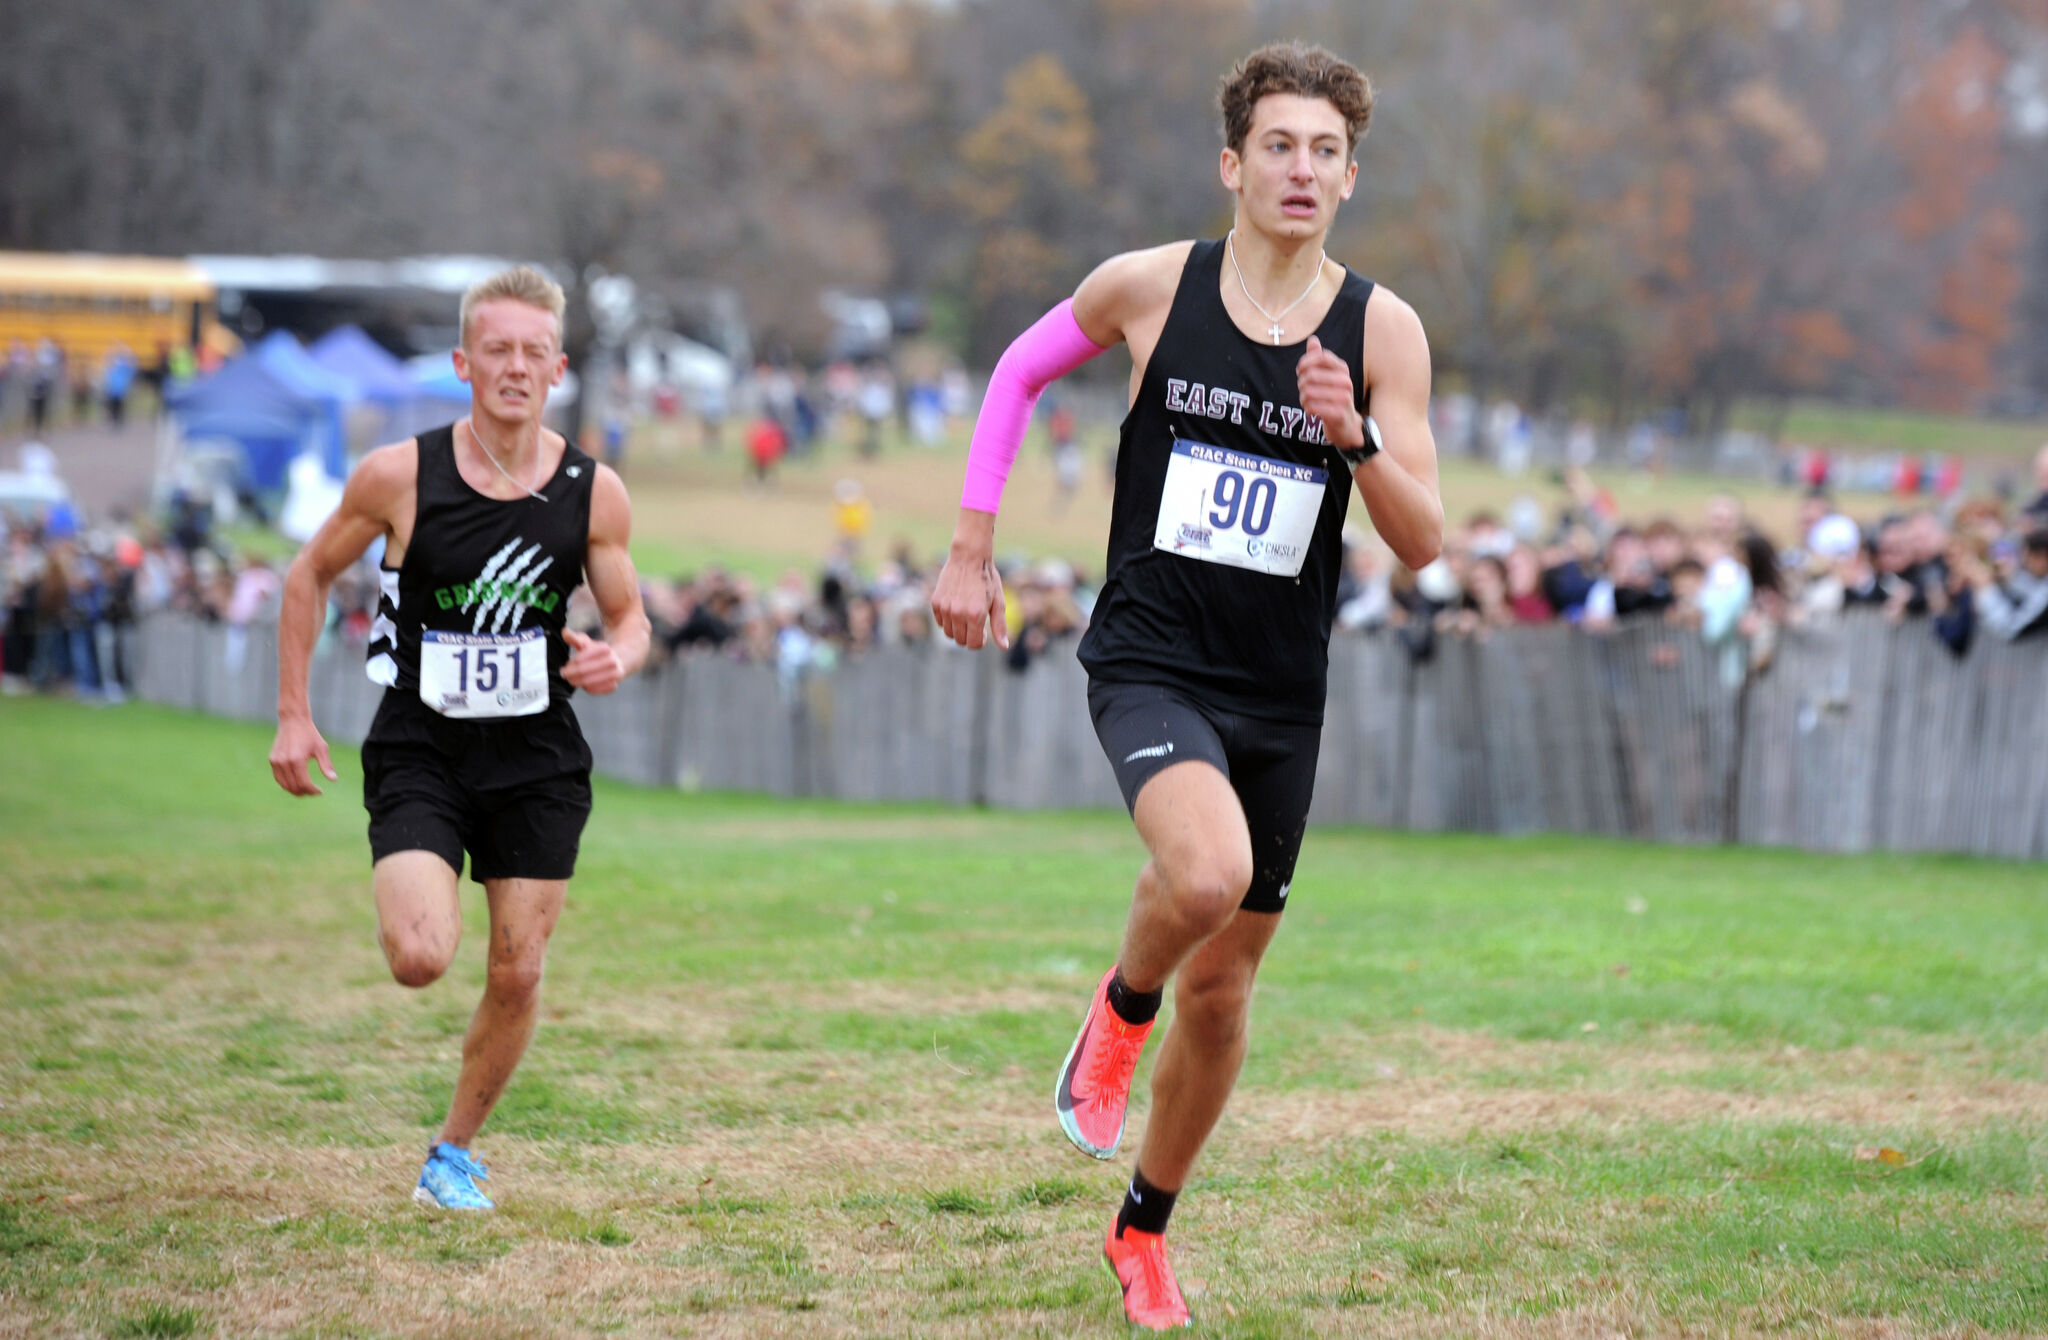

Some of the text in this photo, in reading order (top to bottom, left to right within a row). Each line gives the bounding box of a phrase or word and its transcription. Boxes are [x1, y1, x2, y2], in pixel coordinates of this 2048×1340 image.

[1166, 378, 1332, 446] EAST LYM
[1190, 445, 1312, 482] CIAC State Open XC
[1209, 470, 1277, 536] 90
[453, 647, 520, 692] 151
